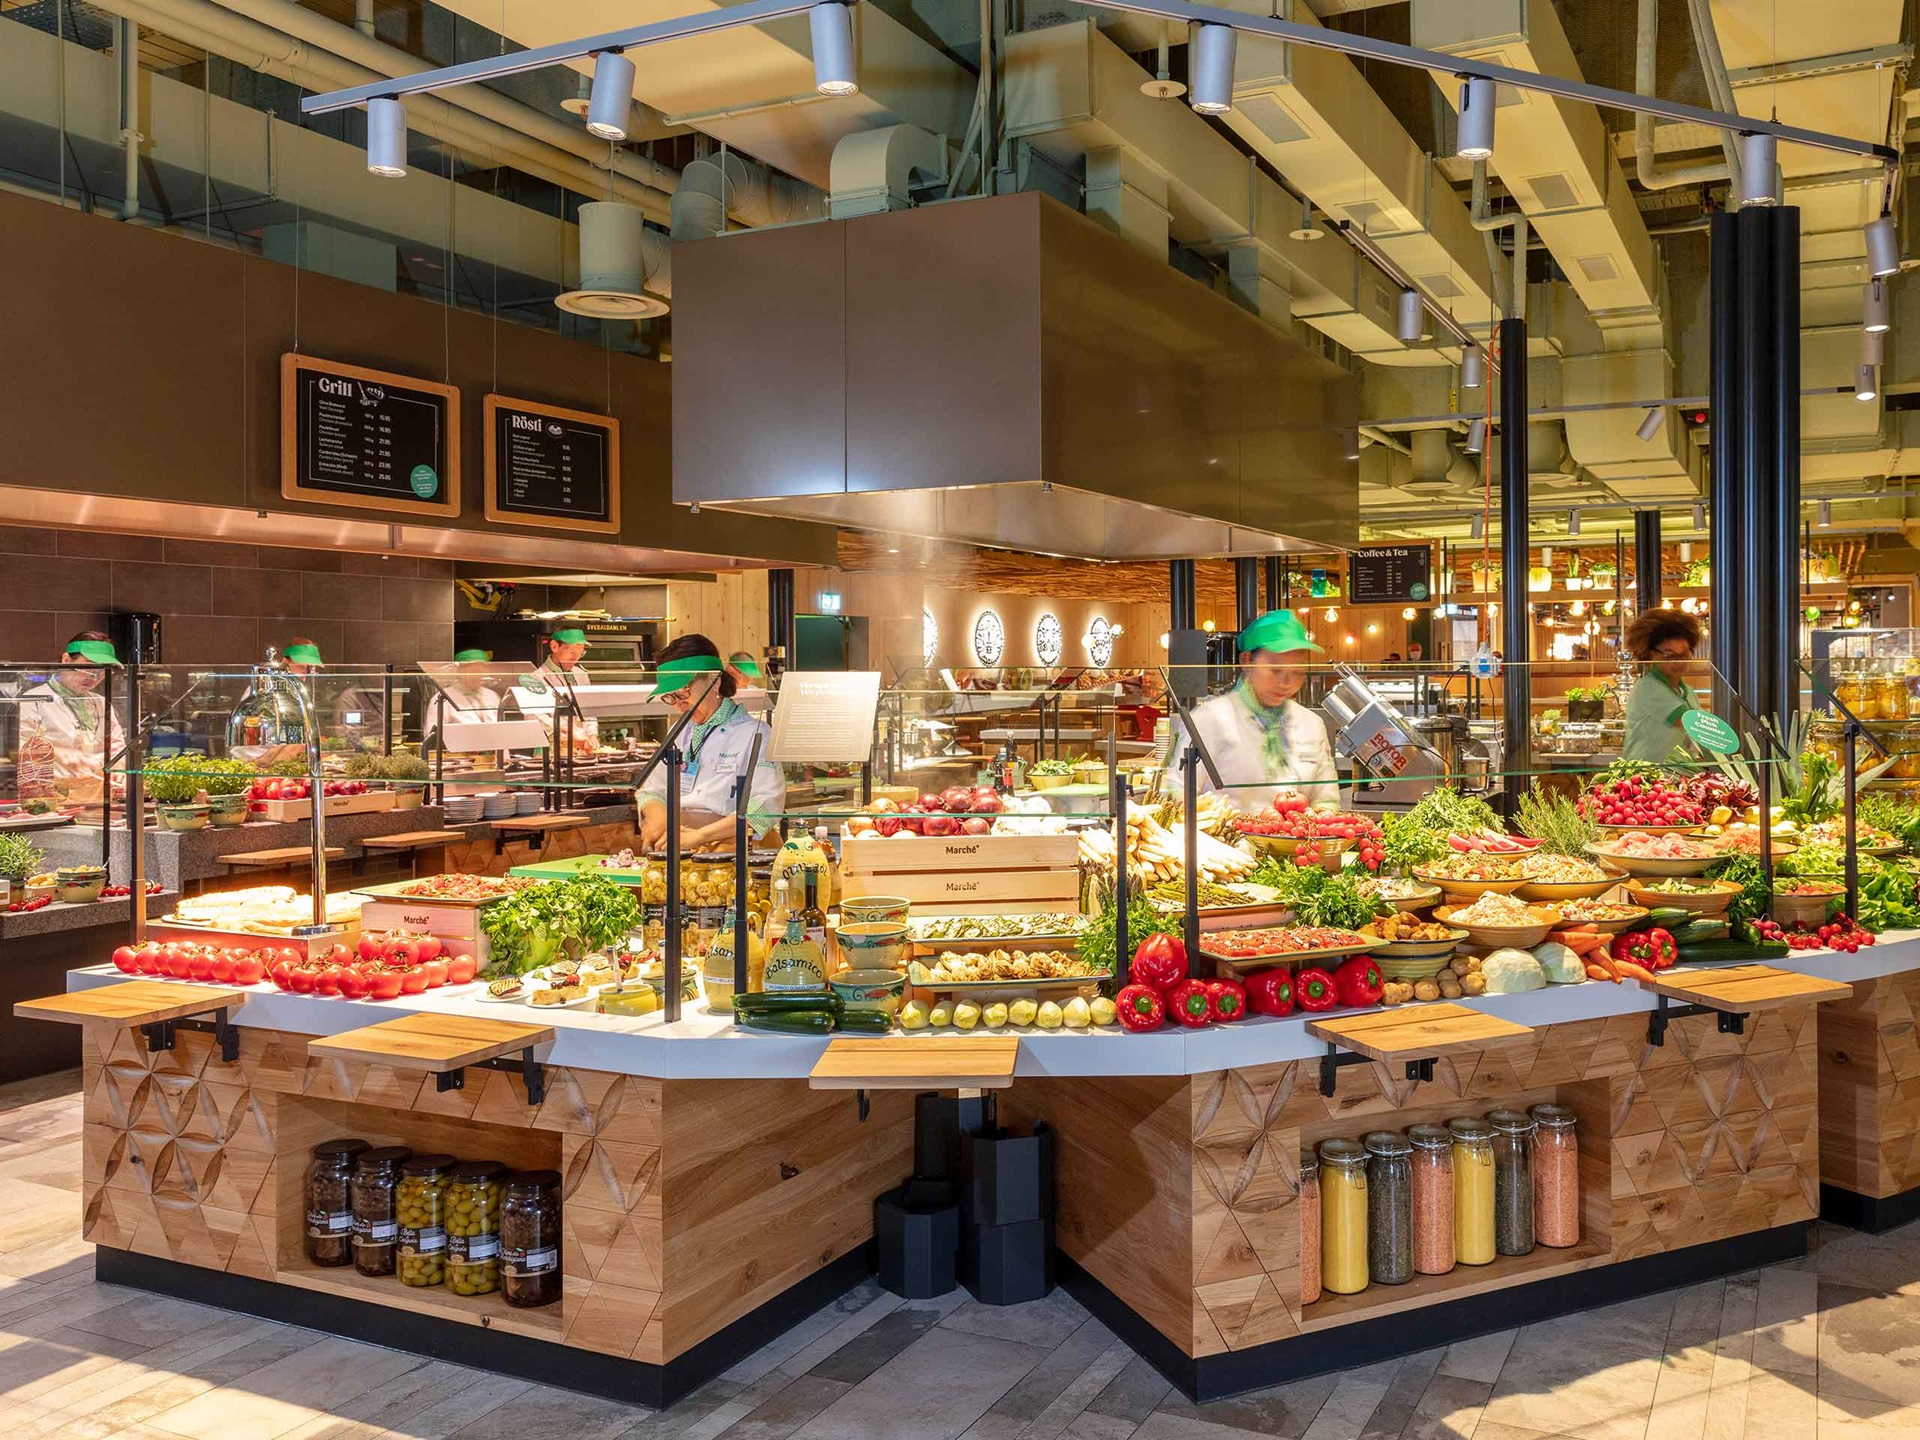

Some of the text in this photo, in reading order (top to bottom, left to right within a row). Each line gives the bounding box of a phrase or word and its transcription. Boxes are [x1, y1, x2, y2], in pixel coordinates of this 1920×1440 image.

[318, 377, 353, 398] Grill
[512, 415, 542, 432] Rösti
[1358, 549, 1408, 558] Coffee & Tea
[1373, 732, 1407, 769] ROTOR
[766, 958, 822, 980] Balsamico
